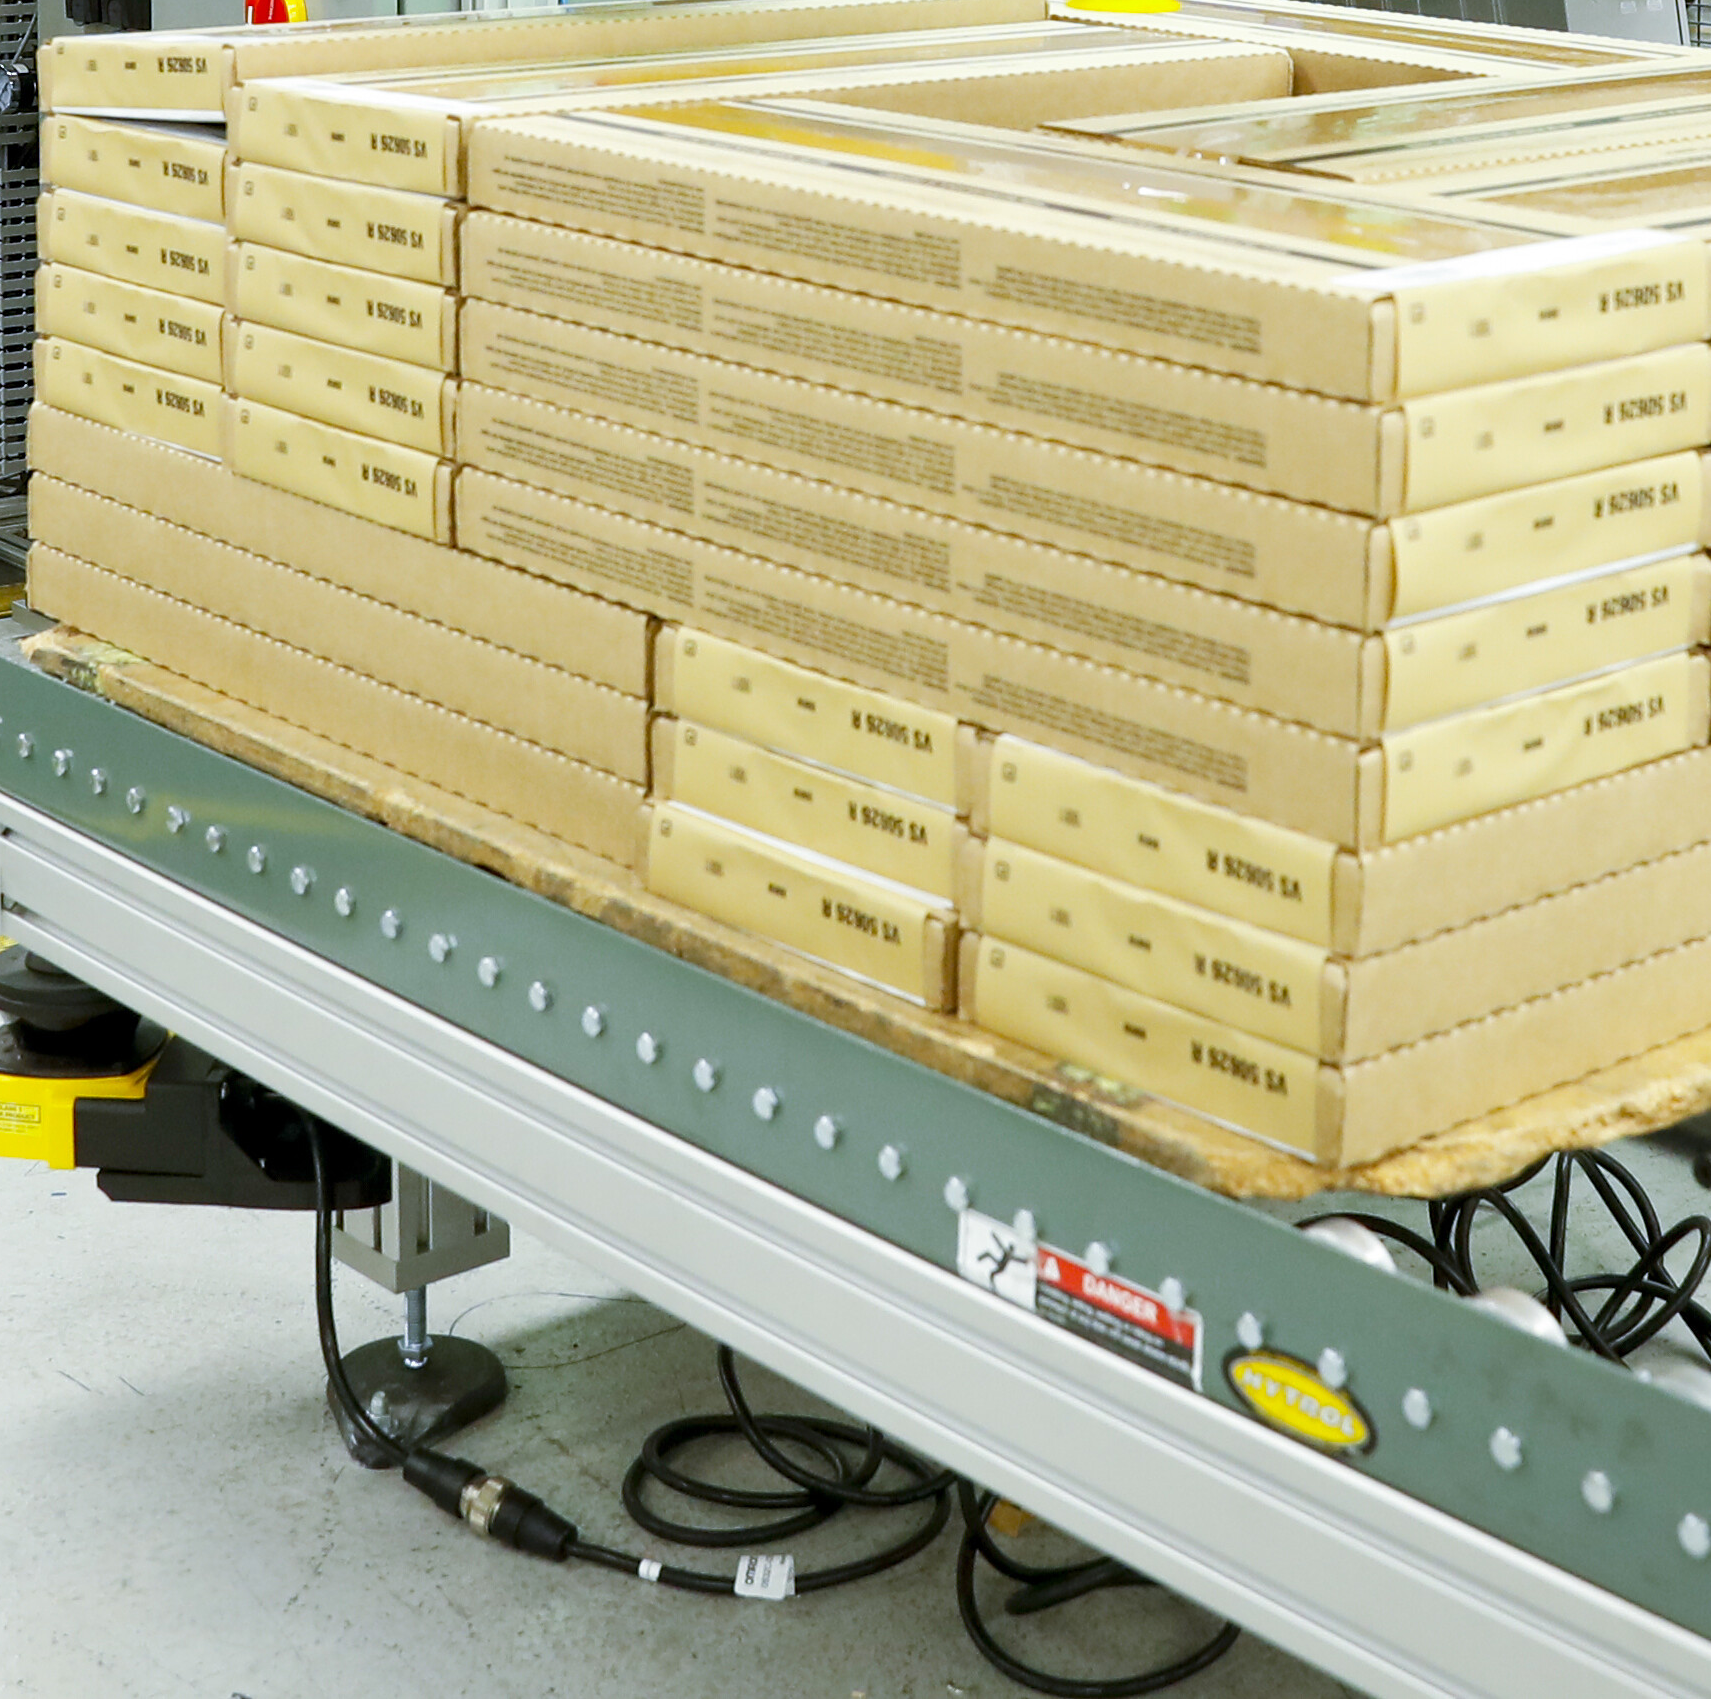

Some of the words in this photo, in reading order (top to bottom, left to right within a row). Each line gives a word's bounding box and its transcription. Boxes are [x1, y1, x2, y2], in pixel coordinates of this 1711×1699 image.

[195, 57, 208, 74] VS
[413, 139, 428, 158] VS
[197, 168, 209, 186] VS
[410, 230, 424, 249] VS
[197, 257, 210, 275] VS
[1665, 280, 1685, 303] VS
[408, 309, 423, 329] VS
[194, 328, 207, 346] VS
[192, 398, 206, 417] VS
[410, 399, 425, 419] VS
[1668, 391, 1687, 414] VS
[403, 478, 418, 498] VS
[1659, 482, 1680, 506] VS
[1650, 585, 1669, 608] VS
[1647, 695, 1665, 718] VS
[912, 728, 933, 754] VS
[908, 820, 928, 846] VS
[1279, 875, 1302, 902] VS
[881, 920, 901, 945] VS
[1268, 980, 1291, 1007] VS
[1263, 1067, 1288, 1096] VS
[1082, 1272, 1158, 1325] DANGER
[1241, 1366, 1354, 1438] HYTROL
